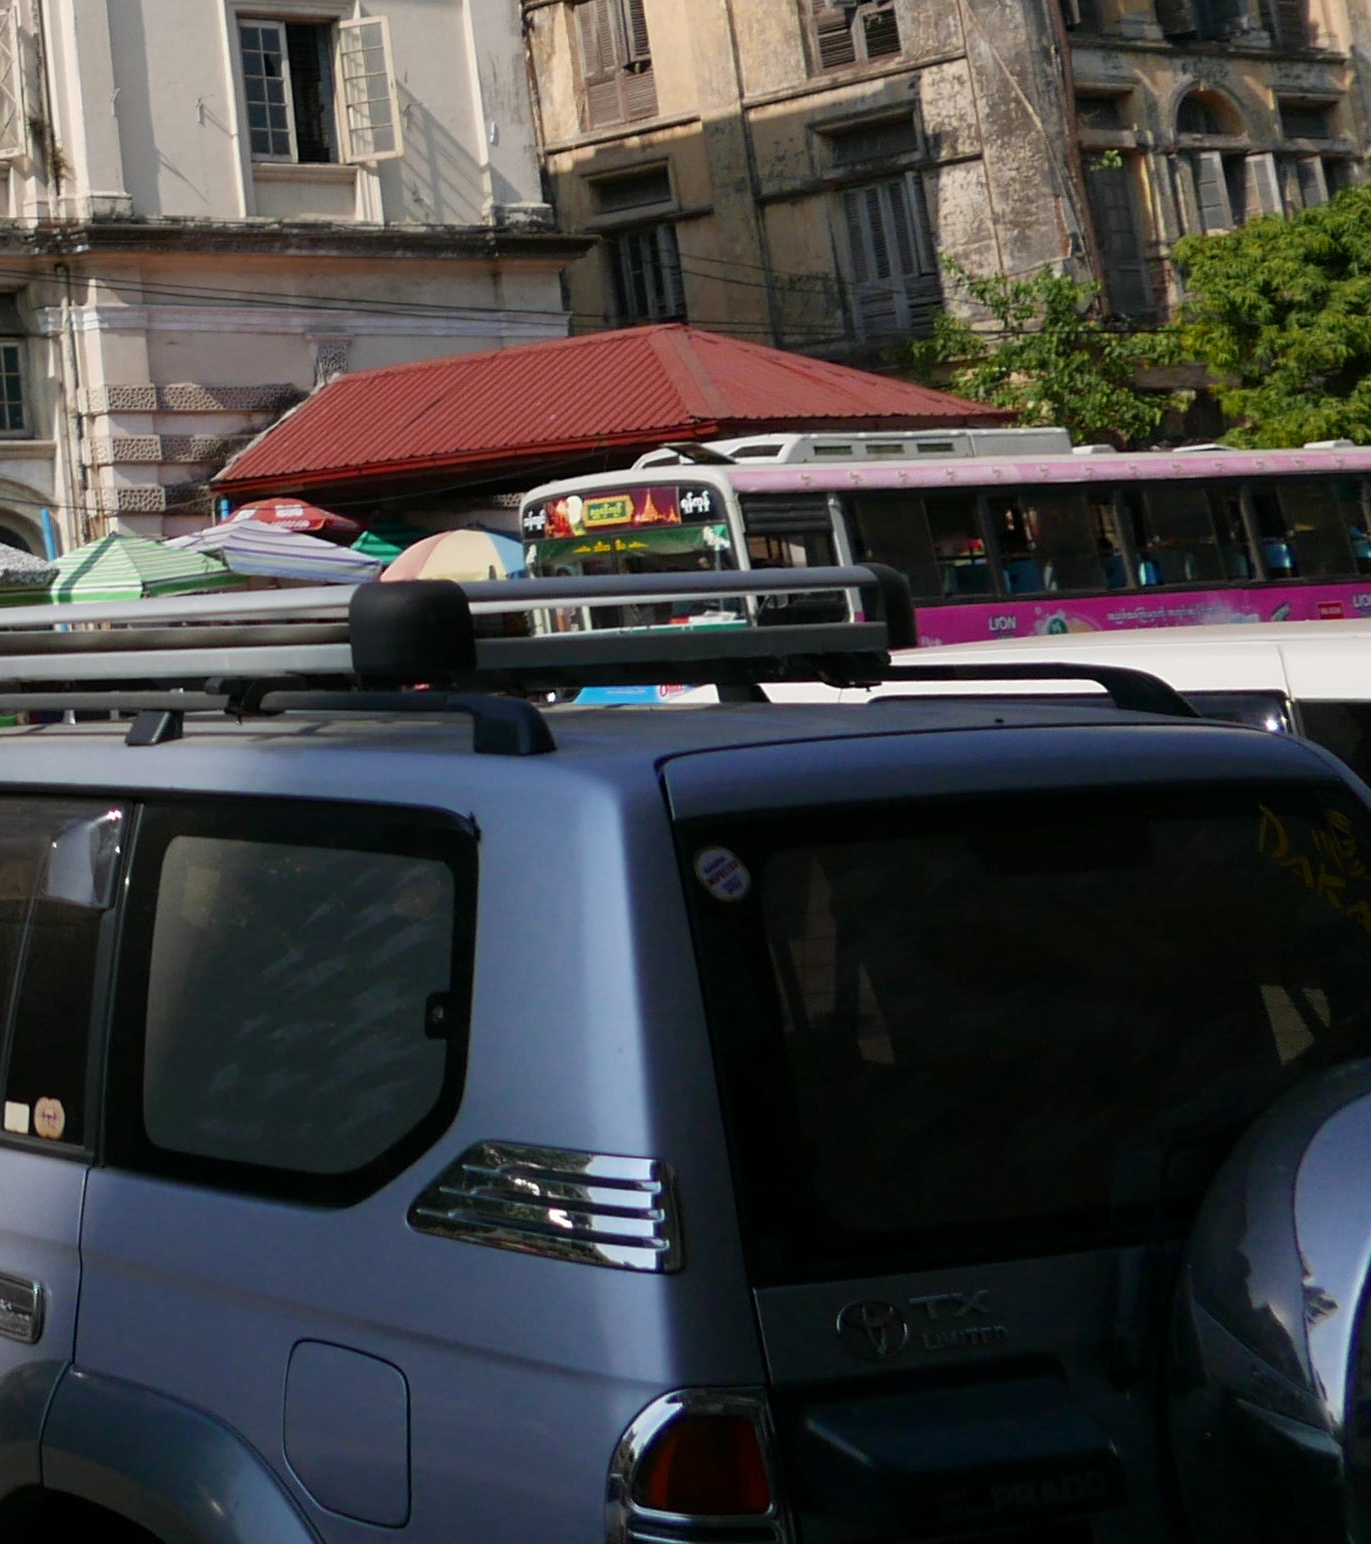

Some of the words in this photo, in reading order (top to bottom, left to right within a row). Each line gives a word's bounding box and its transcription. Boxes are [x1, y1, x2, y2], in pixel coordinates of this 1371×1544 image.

[1353, 593, 1371, 608] LIO
[988, 615, 1017, 631] LION
[908, 1289, 989, 1320] TX
